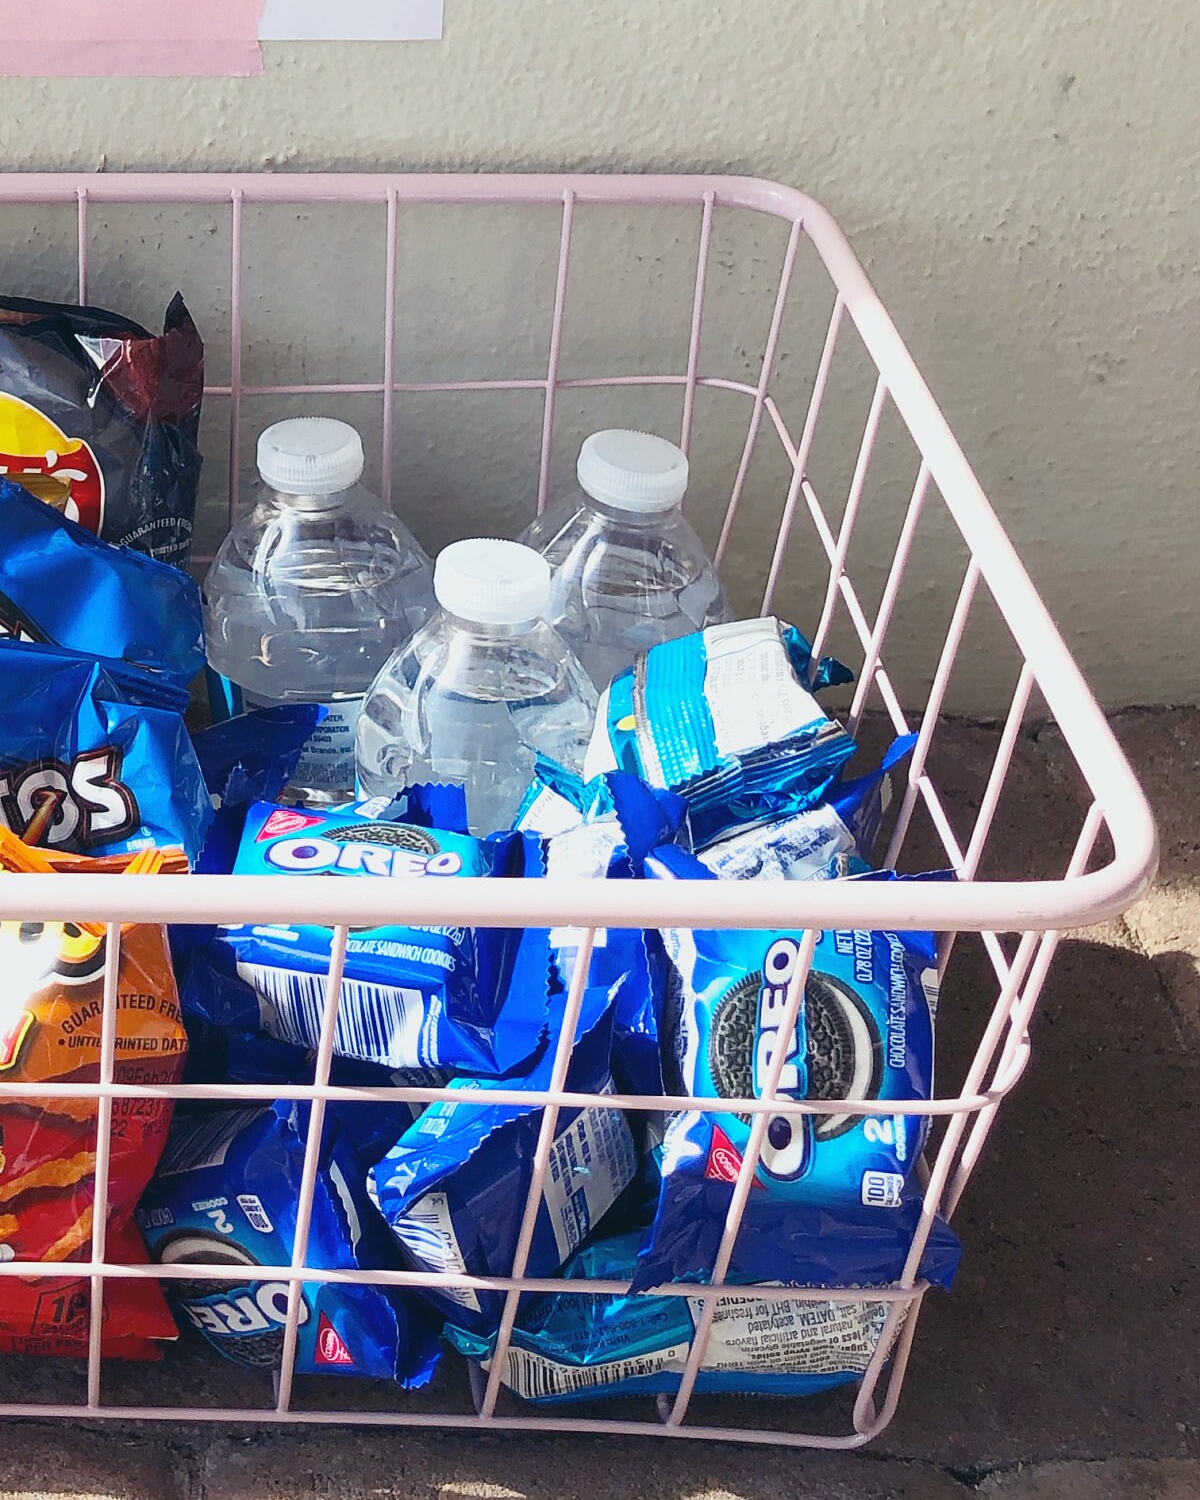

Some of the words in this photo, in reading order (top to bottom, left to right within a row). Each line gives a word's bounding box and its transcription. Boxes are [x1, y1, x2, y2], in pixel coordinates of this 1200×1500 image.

[120, 517, 176, 546] GUARANTEED
[268, 837, 462, 877] OREO
[836, 934, 854, 954] NET
[855, 946, 872, 960] OZ
[376, 938, 420, 962] SANDWICH
[419, 946, 456, 972] COOKIES
[855, 960, 873, 982] 0.78
[889, 964, 907, 1014] SANDWICH
[60, 994, 156, 1035] GUARTEED
[159, 999, 183, 1024] FRE
[111, 1037, 158, 1051] RINTED
[889, 1015, 906, 1068] CHOCOLATE
[756, 943, 805, 1176] OREO
[863, 1117, 894, 1145] 2
[866, 1176, 885, 1203] 100
[206, 1209, 234, 1234] 2
[248, 1212, 269, 1229] 100
[755, 1305, 769, 1319] for
[772, 1300, 790, 1316] BHT
[748, 1315, 794, 1333] acetylated
[801, 1329, 818, 1339] and
[821, 1320, 853, 1336] natural
[761, 1330, 798, 1344] artificial
[842, 1330, 861, 1343] less
